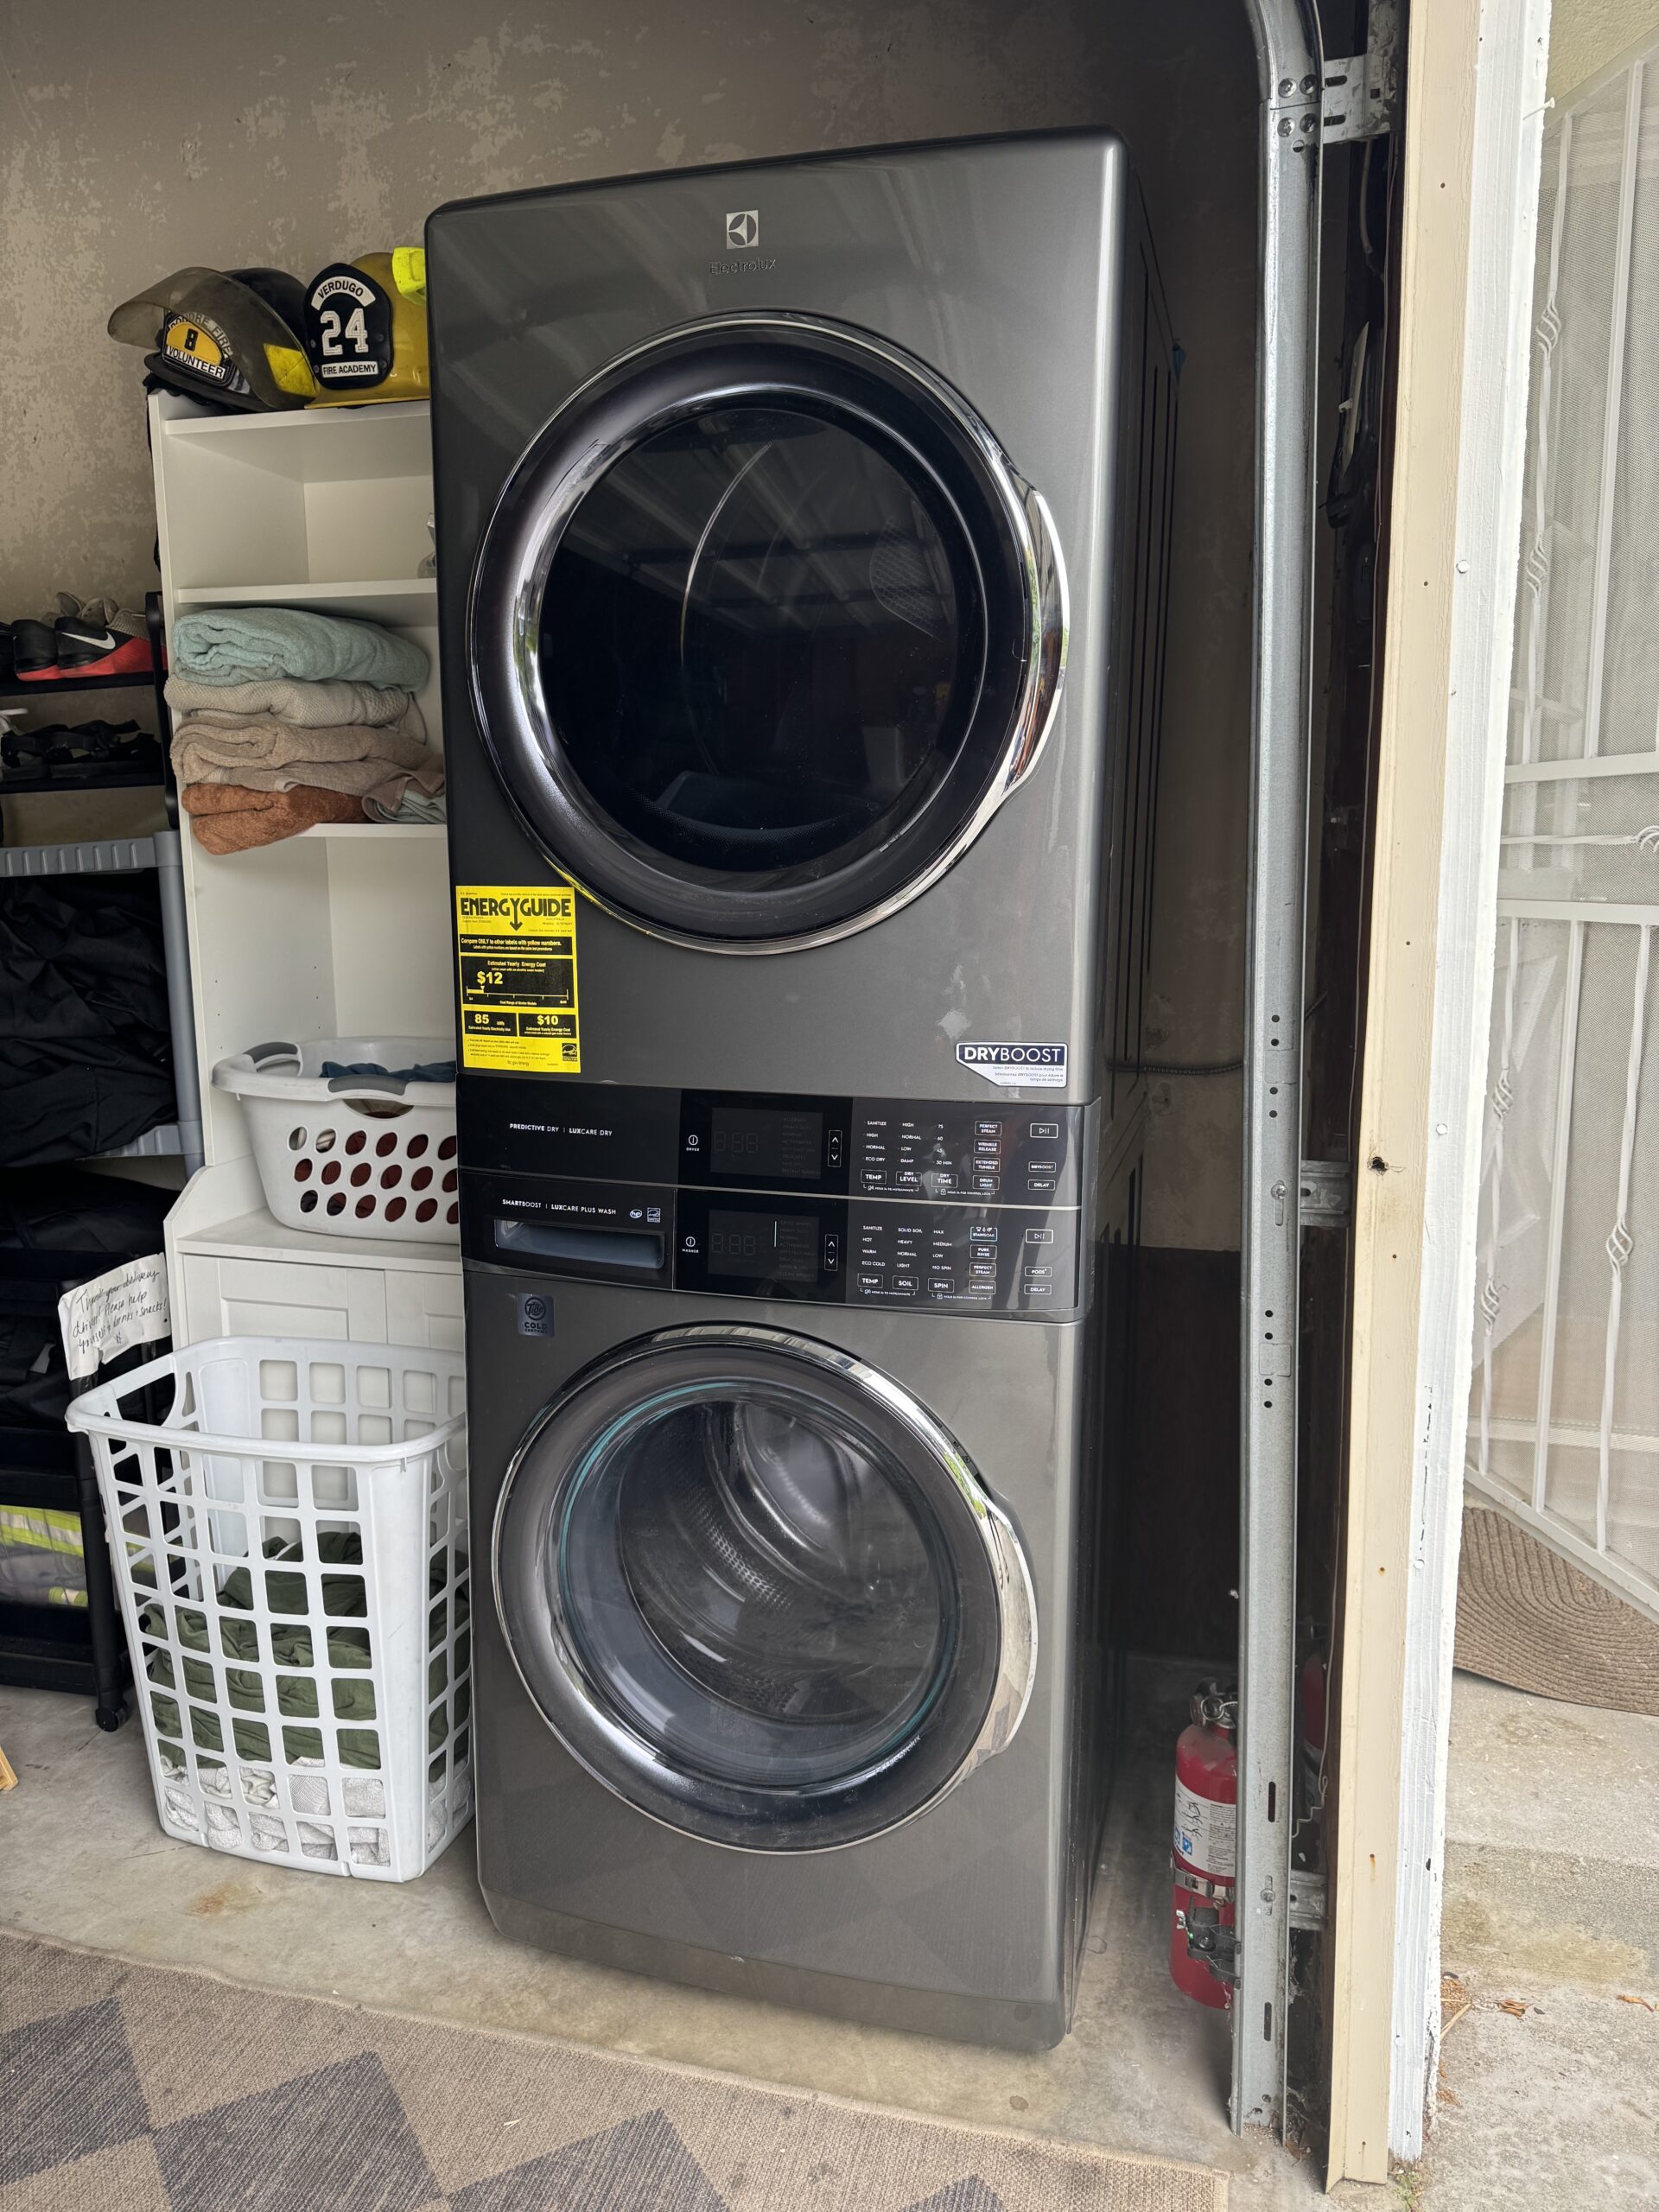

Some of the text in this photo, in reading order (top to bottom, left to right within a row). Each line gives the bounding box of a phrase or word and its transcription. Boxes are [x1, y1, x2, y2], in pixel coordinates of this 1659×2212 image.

[709, 258, 776, 275] Electrolux
[317, 280, 364, 299] VERDUGO
[184, 328, 199, 352] 8
[320, 308, 369, 356] 24
[168, 346, 225, 378] VOLUNTEER
[339, 364, 377, 374] ACADEMY
[477, 970, 503, 985] $12
[474, 1014, 489, 1024] 85
[537, 1014, 559, 1026] $10
[964, 1046, 1061, 1062] DRYBOOST
[510, 1123, 545, 1132] PREDICTIVE
[502, 1198, 542, 1208] SMARTBOOST
[550, 1204, 579, 1212] LUXCARE
[76, 1287, 105, 1313] Thank
[123, 1271, 160, 1287] delivery
[105, 1300, 124, 1316] Please
[128, 1291, 148, 1306] help
[113, 1313, 133, 1328] drinks
